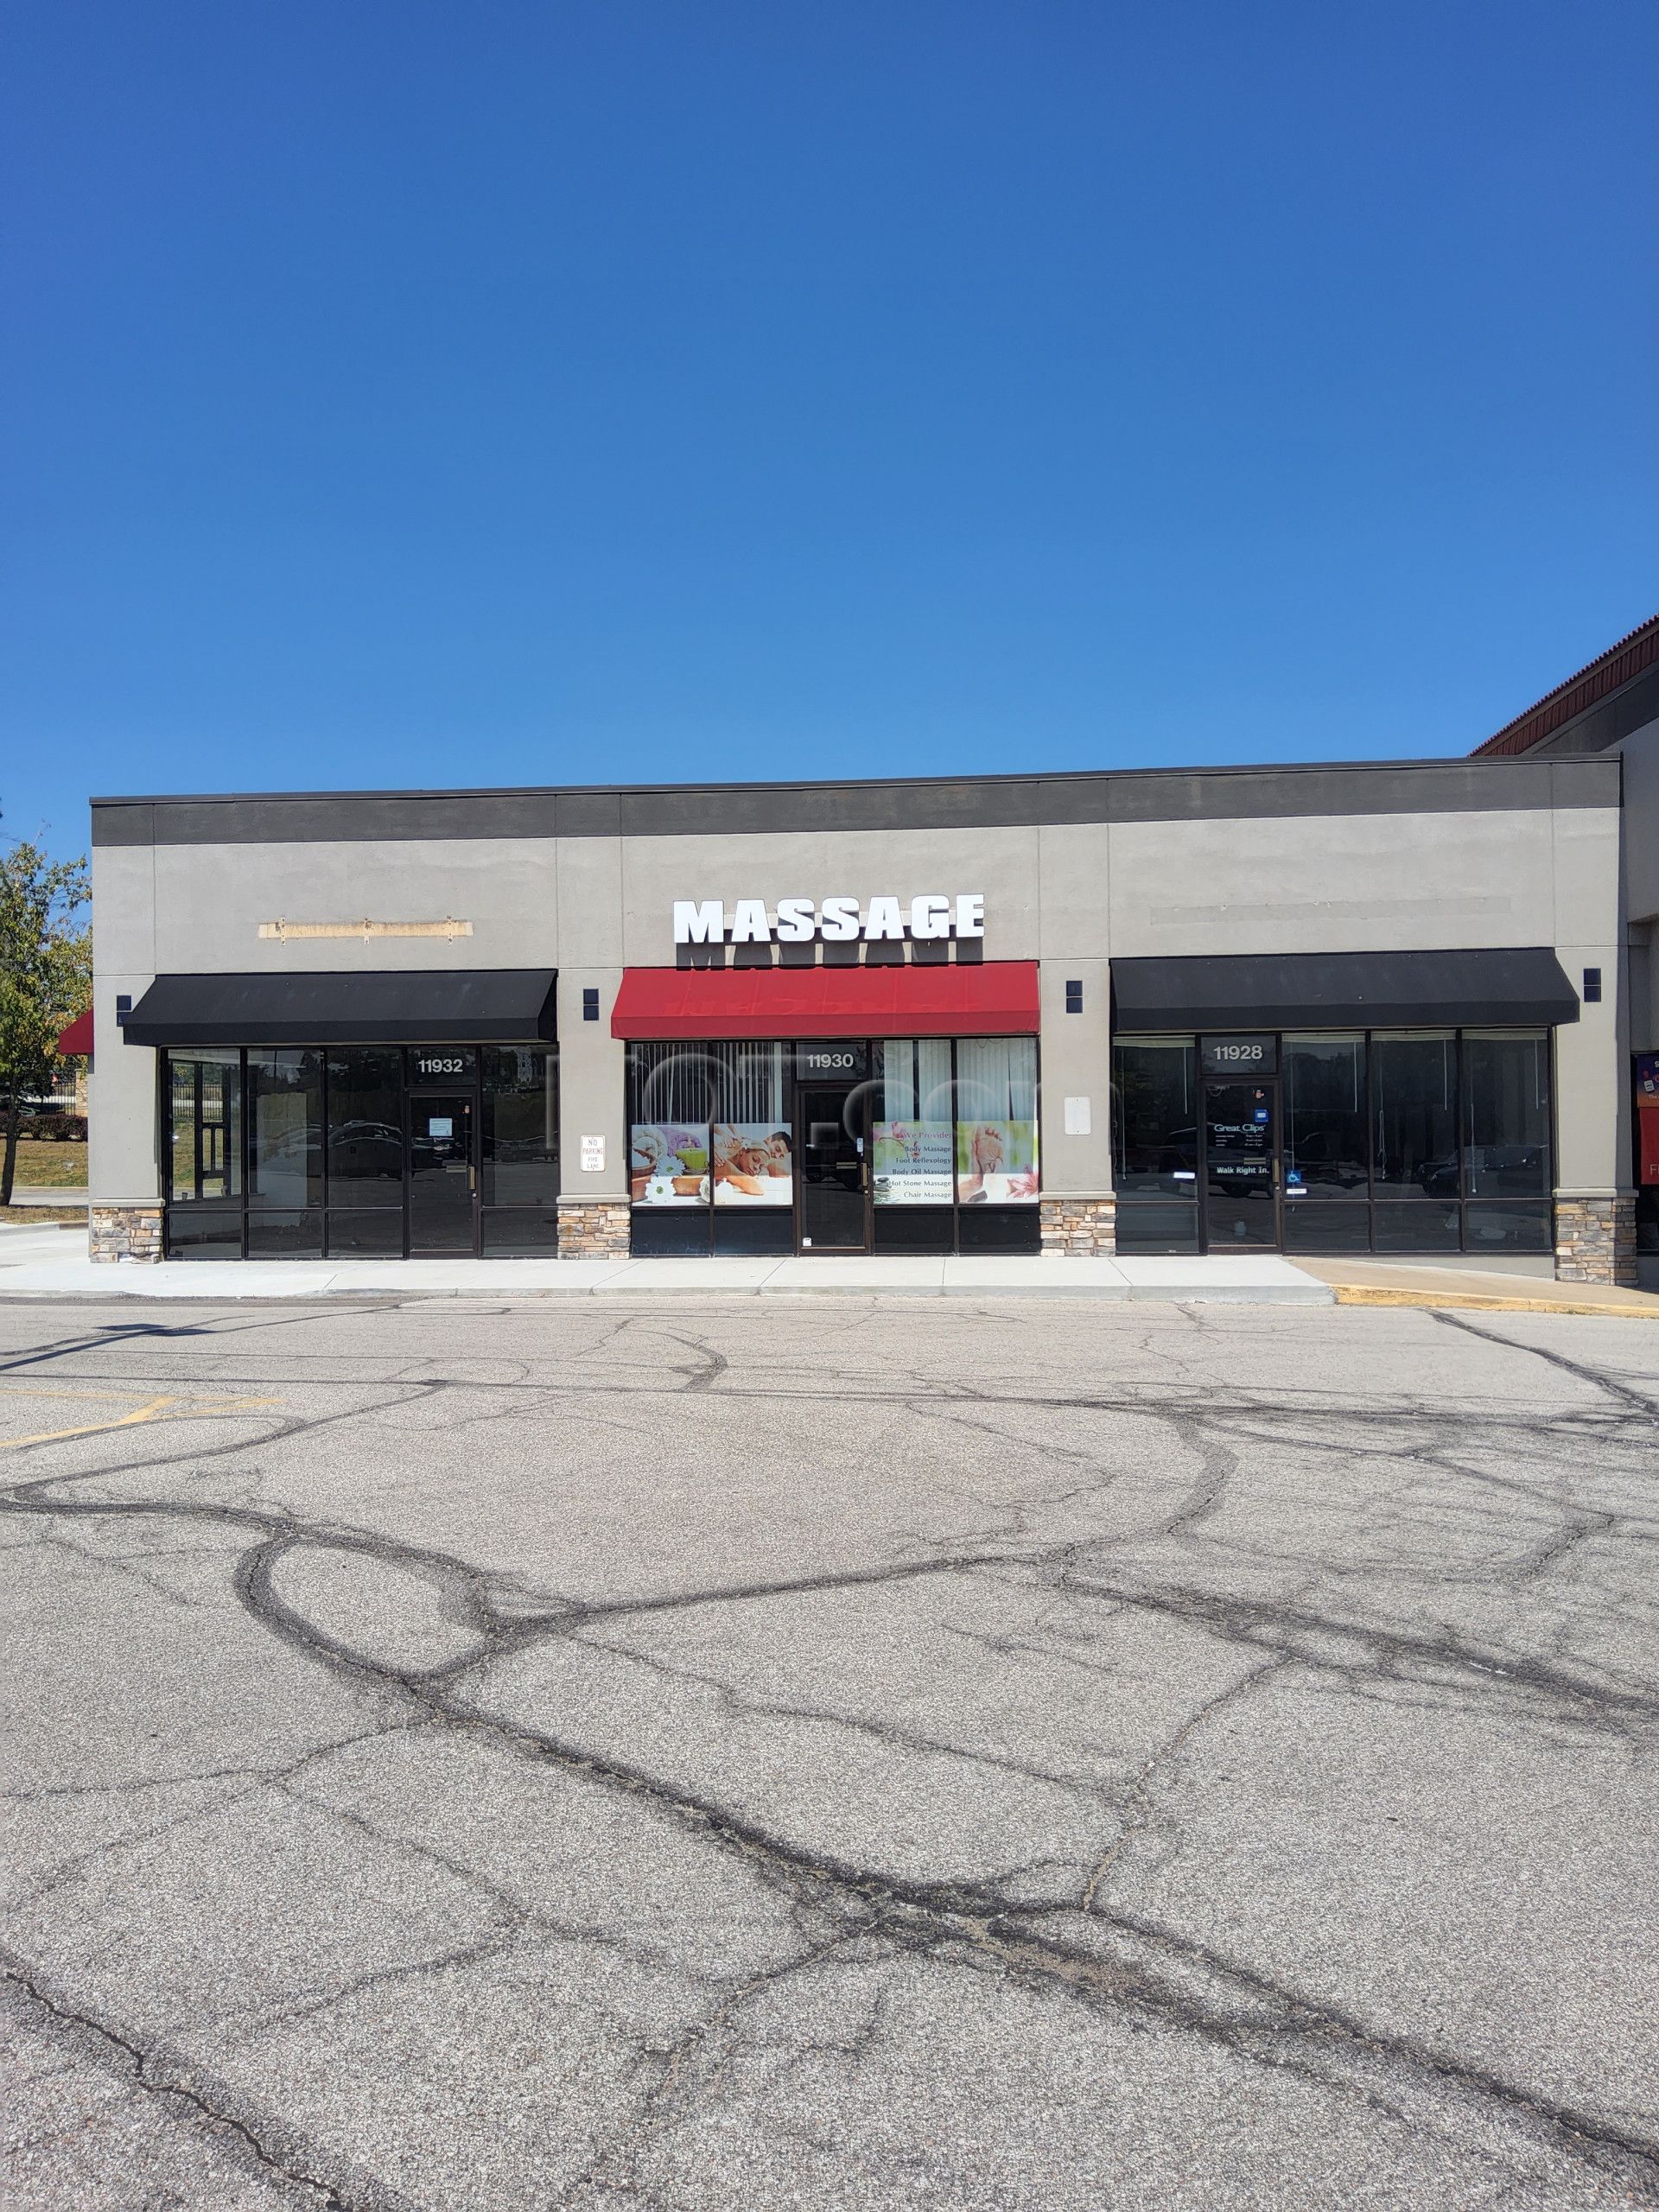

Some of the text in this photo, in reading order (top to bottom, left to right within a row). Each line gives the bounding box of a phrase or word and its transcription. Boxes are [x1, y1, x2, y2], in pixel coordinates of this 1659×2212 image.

[672, 893, 984, 944] MASSAGE
[806, 1053, 854, 1069] 11930
[1213, 1045, 1263, 1061] 11928
[417, 1058, 463, 1074] 11932
[1242, 1123, 1265, 1133] Clips
[1236, 1166, 1256, 1175] Right
